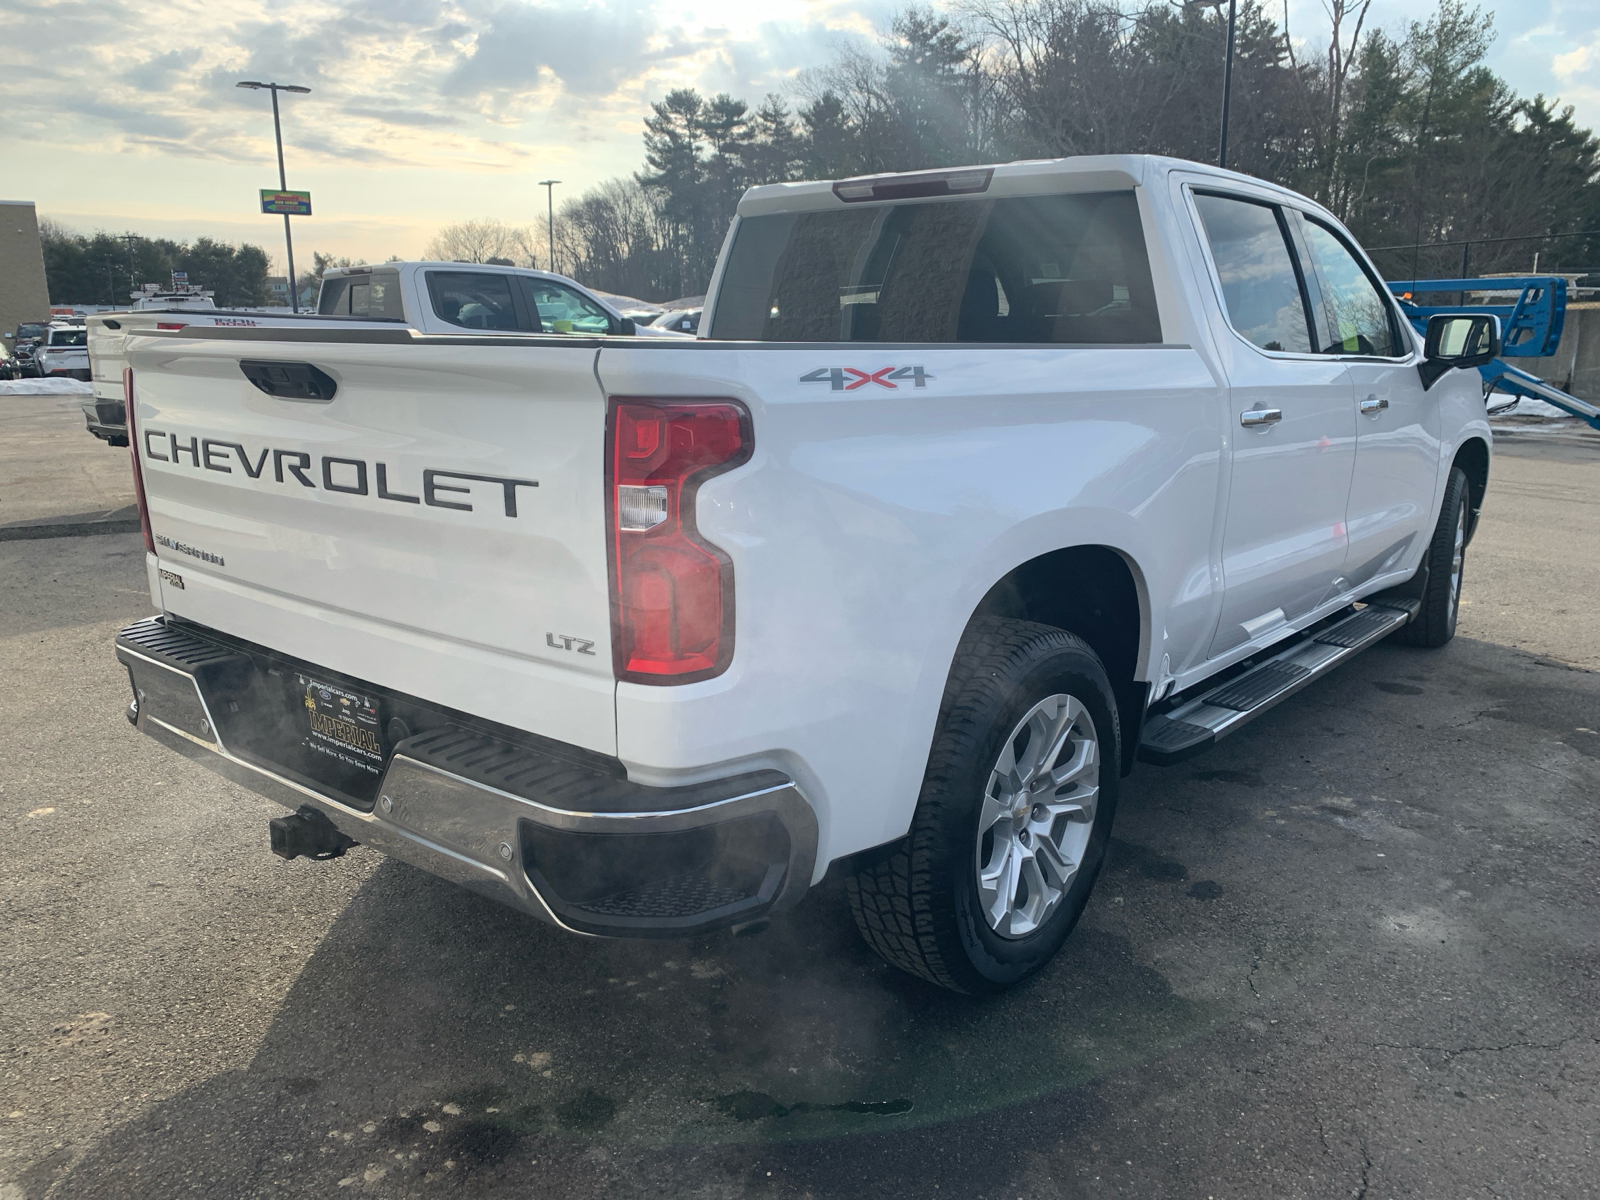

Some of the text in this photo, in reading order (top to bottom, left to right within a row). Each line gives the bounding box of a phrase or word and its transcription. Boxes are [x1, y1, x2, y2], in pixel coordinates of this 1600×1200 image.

[144, 428, 539, 518] CHEVROLET
[155, 533, 225, 566] SILVERADO
[545, 631, 596, 656] LTZ
[309, 709, 380, 754] IMPERIAL
[311, 730, 382, 761] www.imperialcars.com
